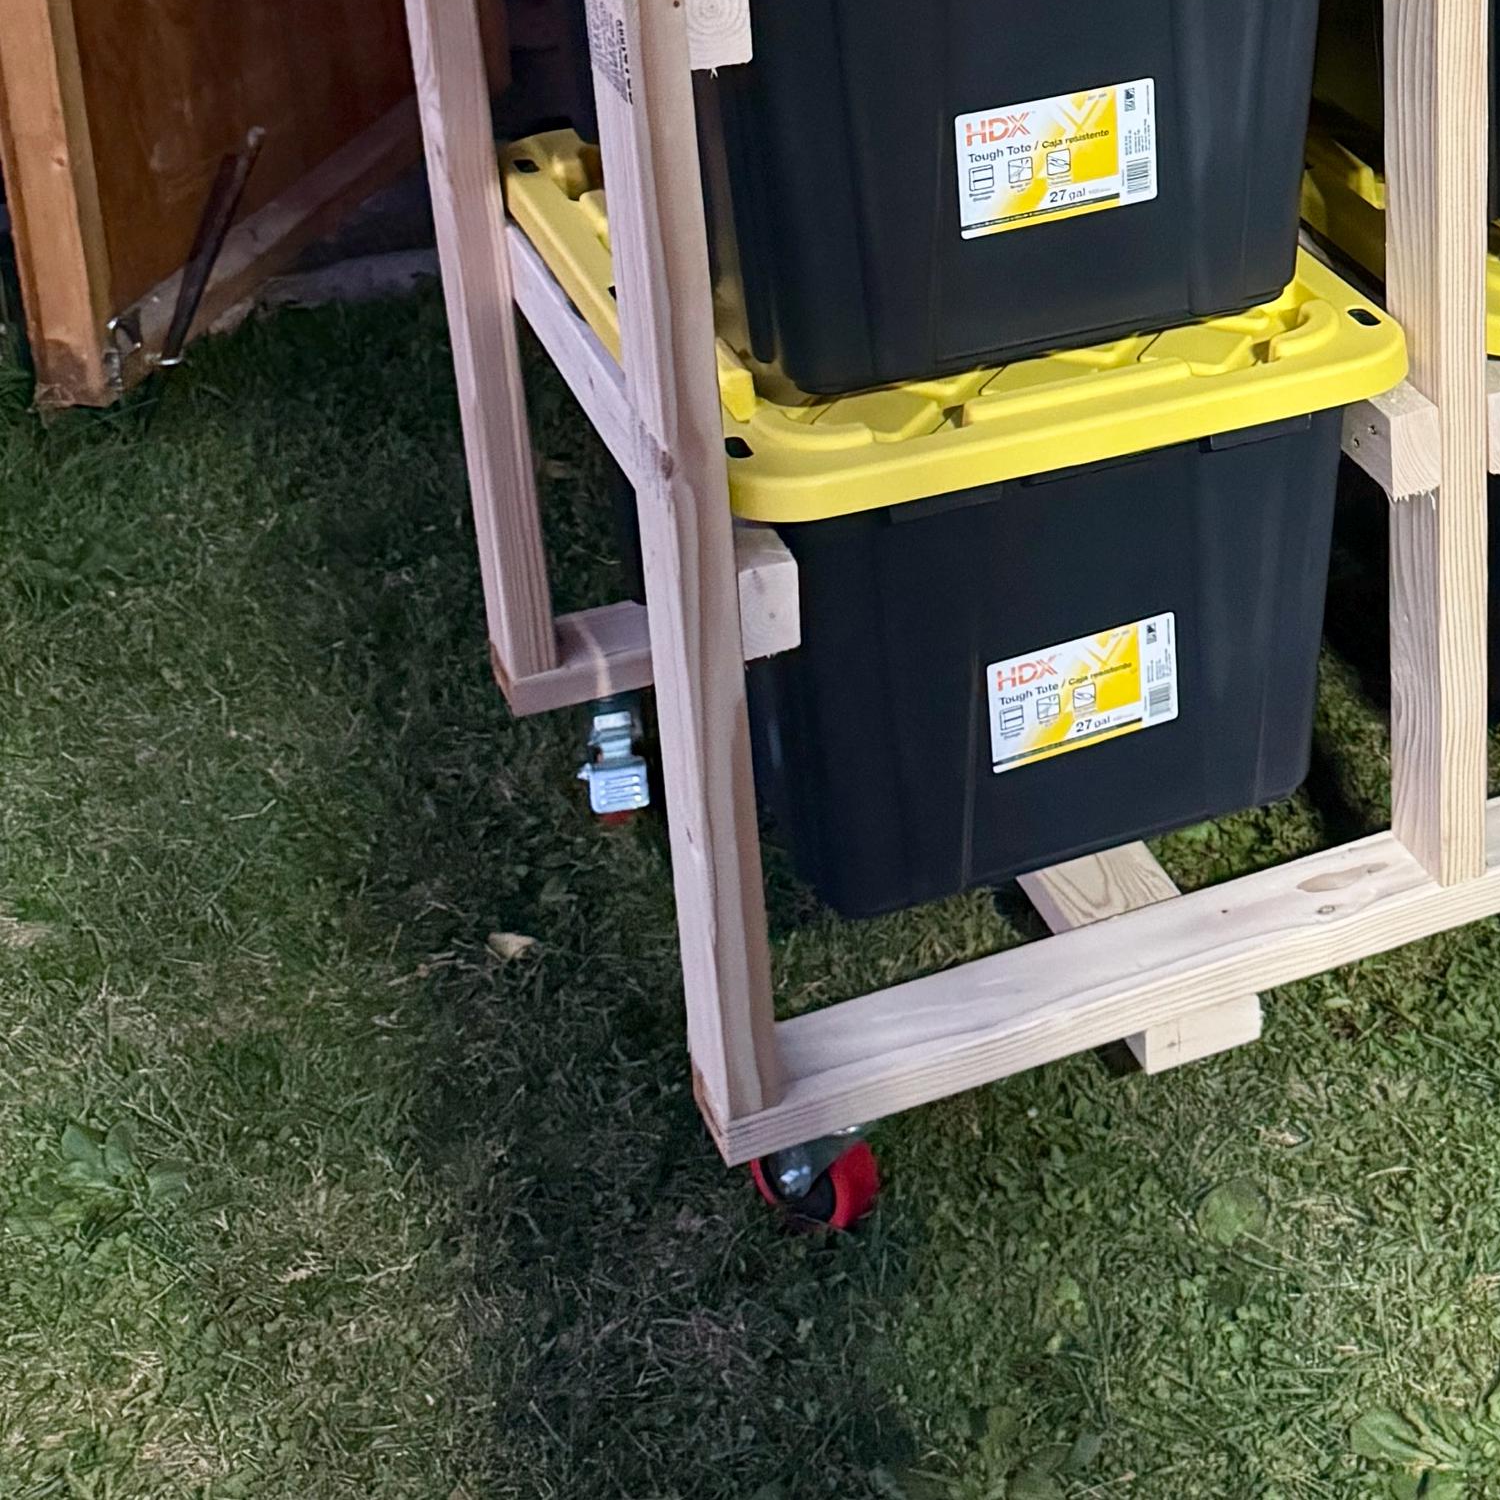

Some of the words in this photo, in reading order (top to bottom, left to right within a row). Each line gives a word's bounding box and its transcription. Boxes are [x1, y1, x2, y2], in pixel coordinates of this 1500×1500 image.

[965, 112, 1030, 147] HDX
[969, 149, 1003, 163] Tough
[1007, 144, 1031, 155] Tote
[1042, 139, 1062, 149] Caja
[1065, 130, 1109, 144] resistente
[1050, 190, 1067, 203] 27
[1069, 188, 1085, 201] gal
[996, 655, 1057, 692] HDX
[1000, 690, 1032, 706] Tough
[1035, 684, 1059, 695] Tote
[1076, 719, 1092, 732] 27
